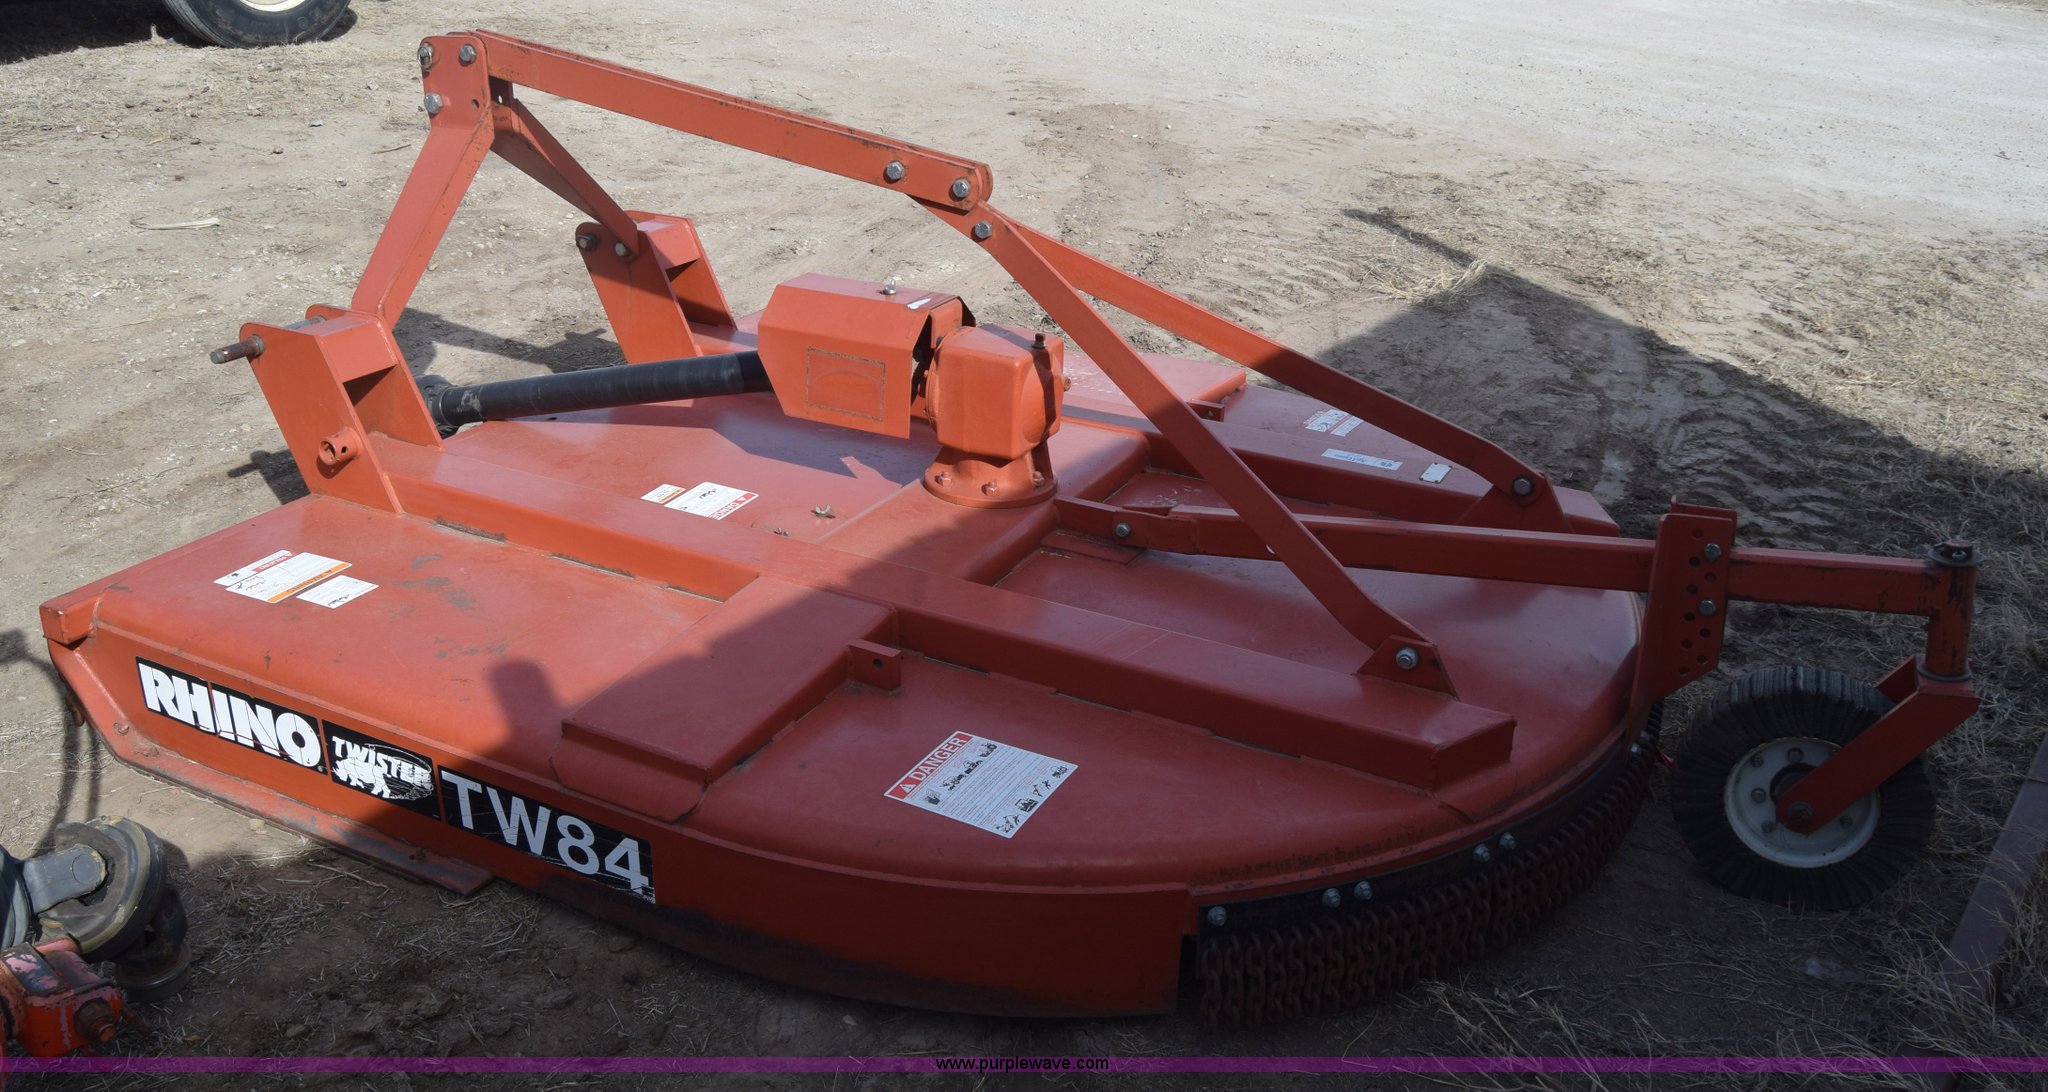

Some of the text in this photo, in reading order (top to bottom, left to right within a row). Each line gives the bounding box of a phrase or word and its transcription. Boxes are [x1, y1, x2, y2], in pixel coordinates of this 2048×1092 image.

[138, 662, 321, 767] RHINO
[332, 736, 431, 790] TWISTER
[909, 737, 967, 781] DANGER
[441, 770, 649, 896] TW84
